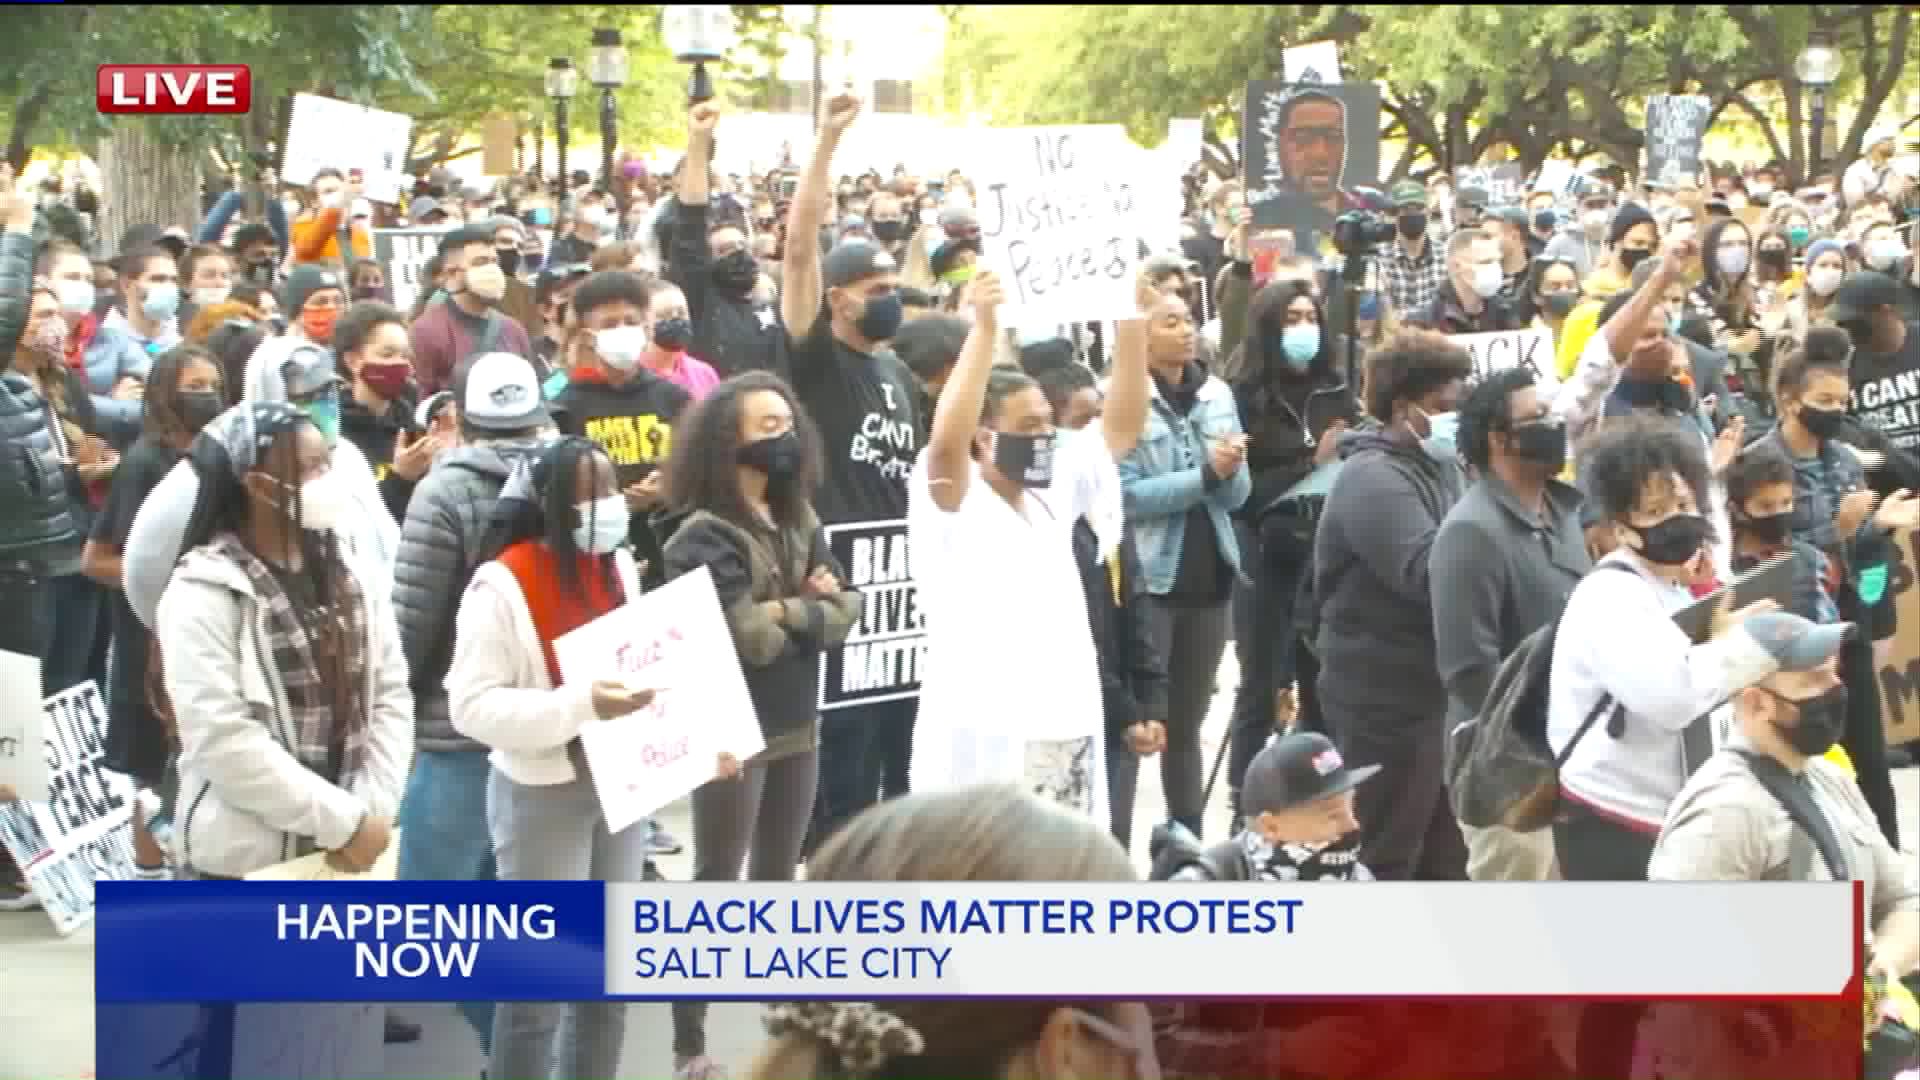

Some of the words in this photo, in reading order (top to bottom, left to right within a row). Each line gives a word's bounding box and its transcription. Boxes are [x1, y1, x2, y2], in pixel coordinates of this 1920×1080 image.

[1468, 334, 1543, 378] ACK
[851, 534, 910, 585] BLA
[841, 641, 923, 693] MATT
